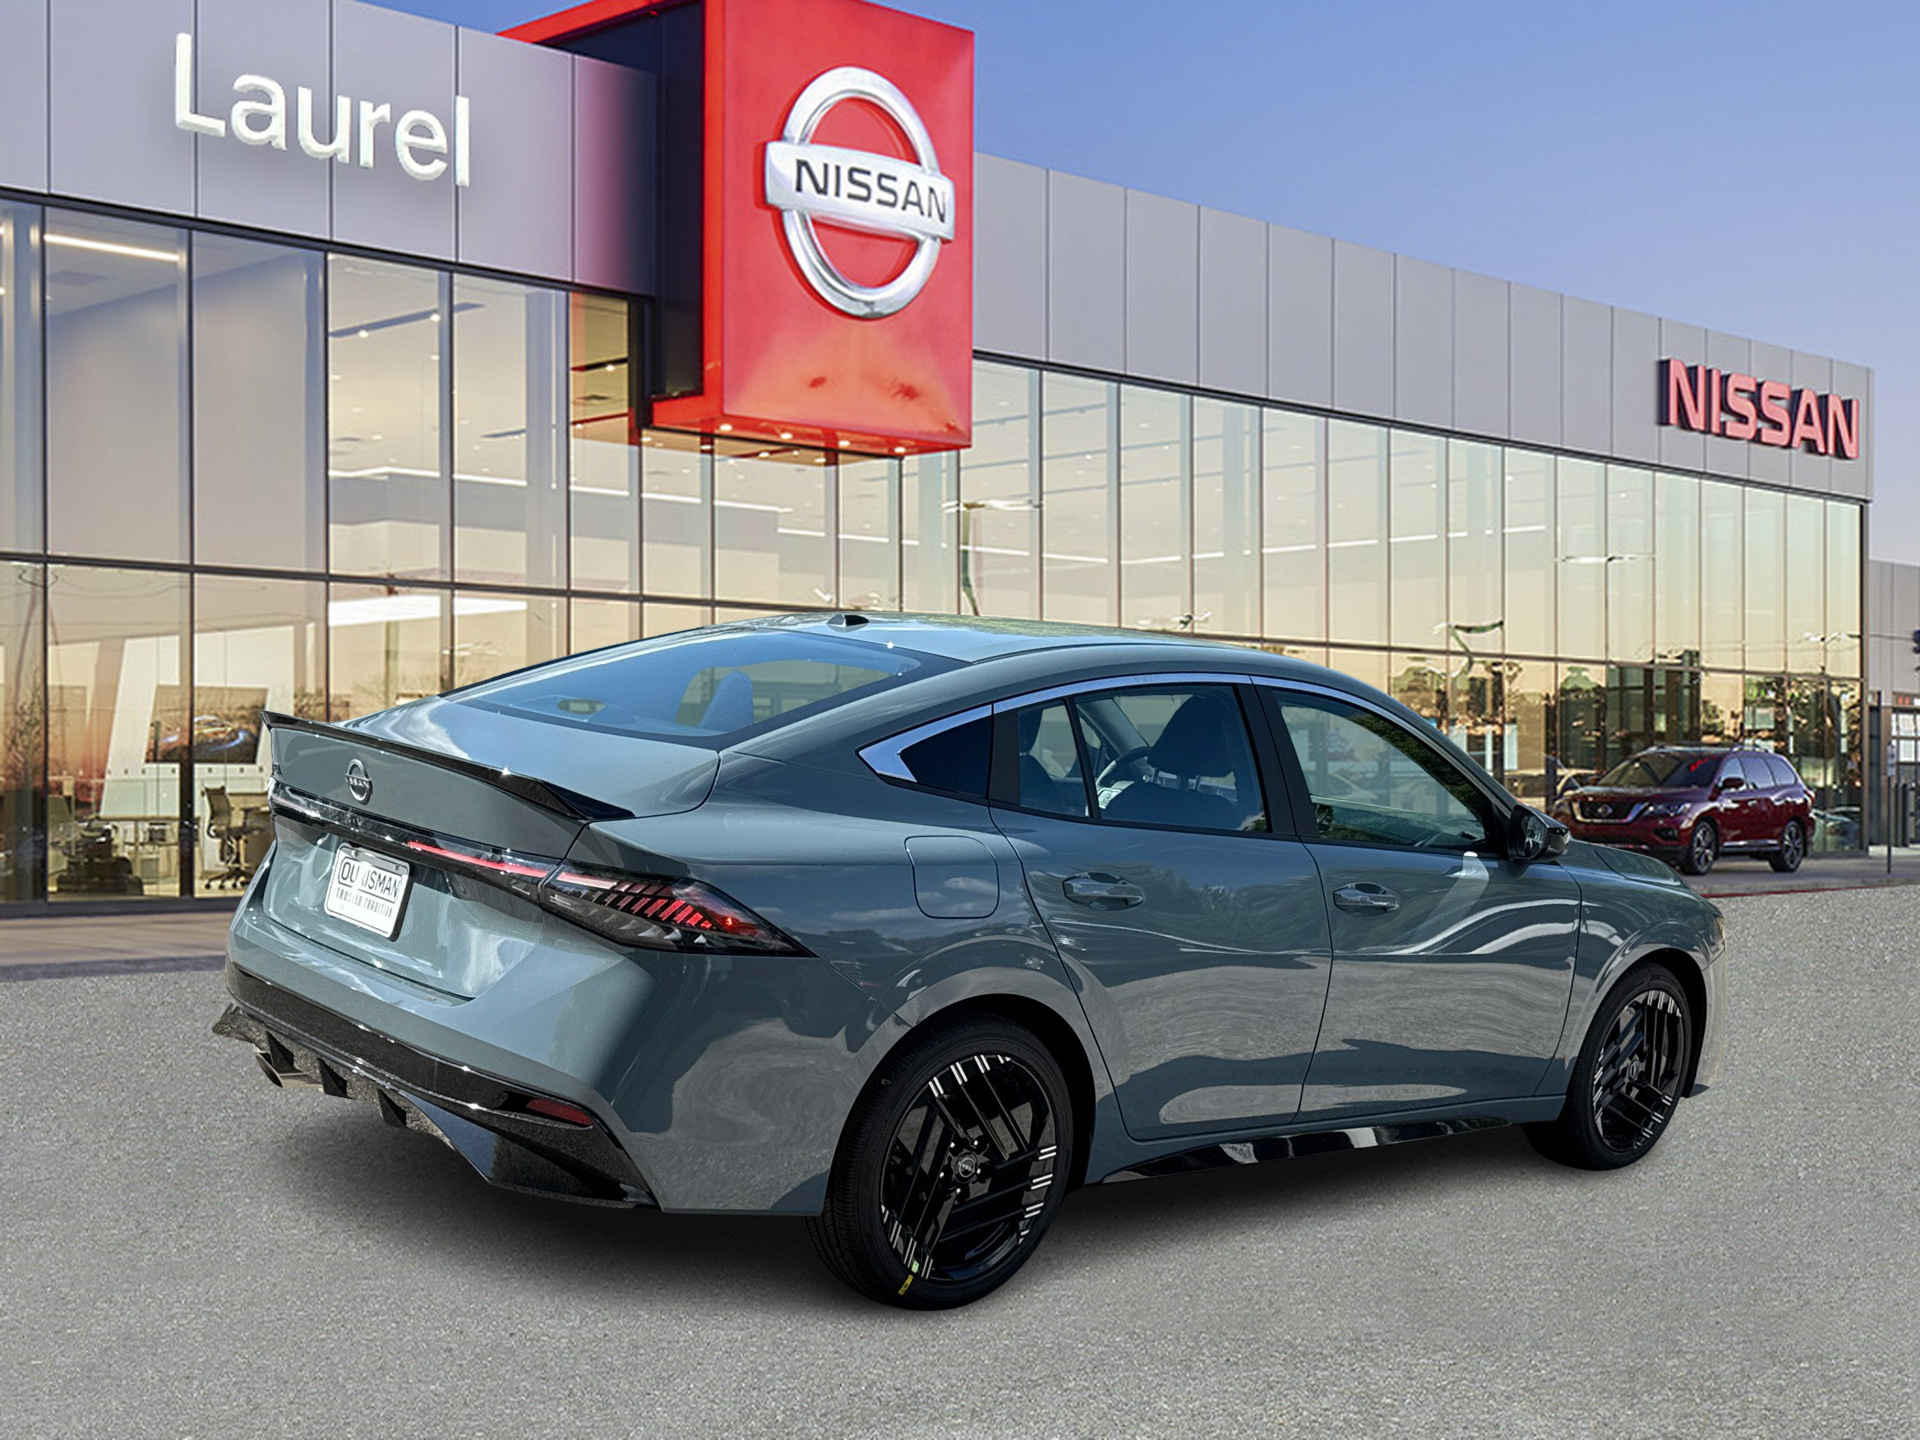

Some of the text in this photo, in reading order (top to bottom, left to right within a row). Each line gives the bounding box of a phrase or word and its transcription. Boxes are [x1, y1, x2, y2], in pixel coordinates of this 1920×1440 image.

[175, 32, 469, 187] Laurel
[795, 158, 946, 223] NISSAN
[1658, 358, 1860, 460] NISSAN
